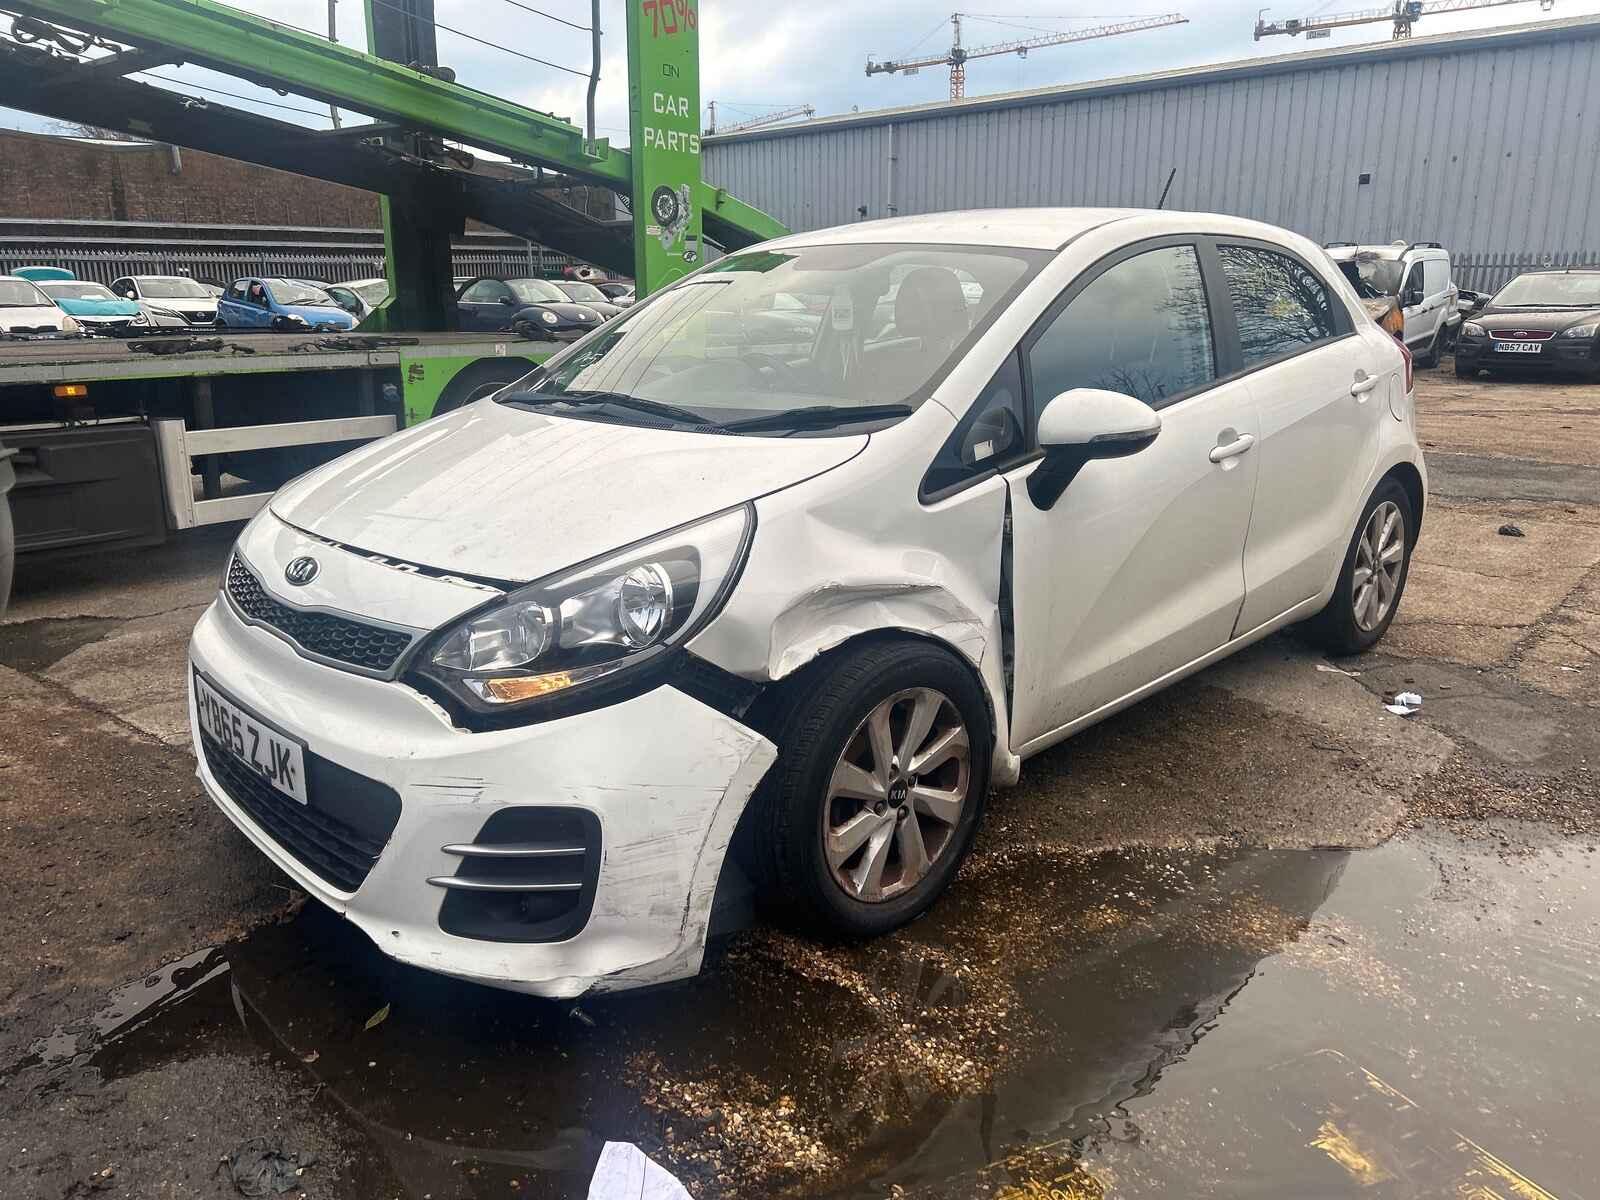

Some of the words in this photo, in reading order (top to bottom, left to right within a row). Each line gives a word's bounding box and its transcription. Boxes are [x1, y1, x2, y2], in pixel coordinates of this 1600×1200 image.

[642, 0, 696, 37] 70%
[662, 63, 680, 78] ON
[653, 92, 689, 118] CAR
[643, 126, 700, 155] PARTS
[1499, 343, 1520, 352] NB57
[1522, 343, 1540, 352] CAV
[288, 559, 314, 581] KIA
[247, 723, 294, 791] ZJK
[890, 789, 906, 799] KIA
